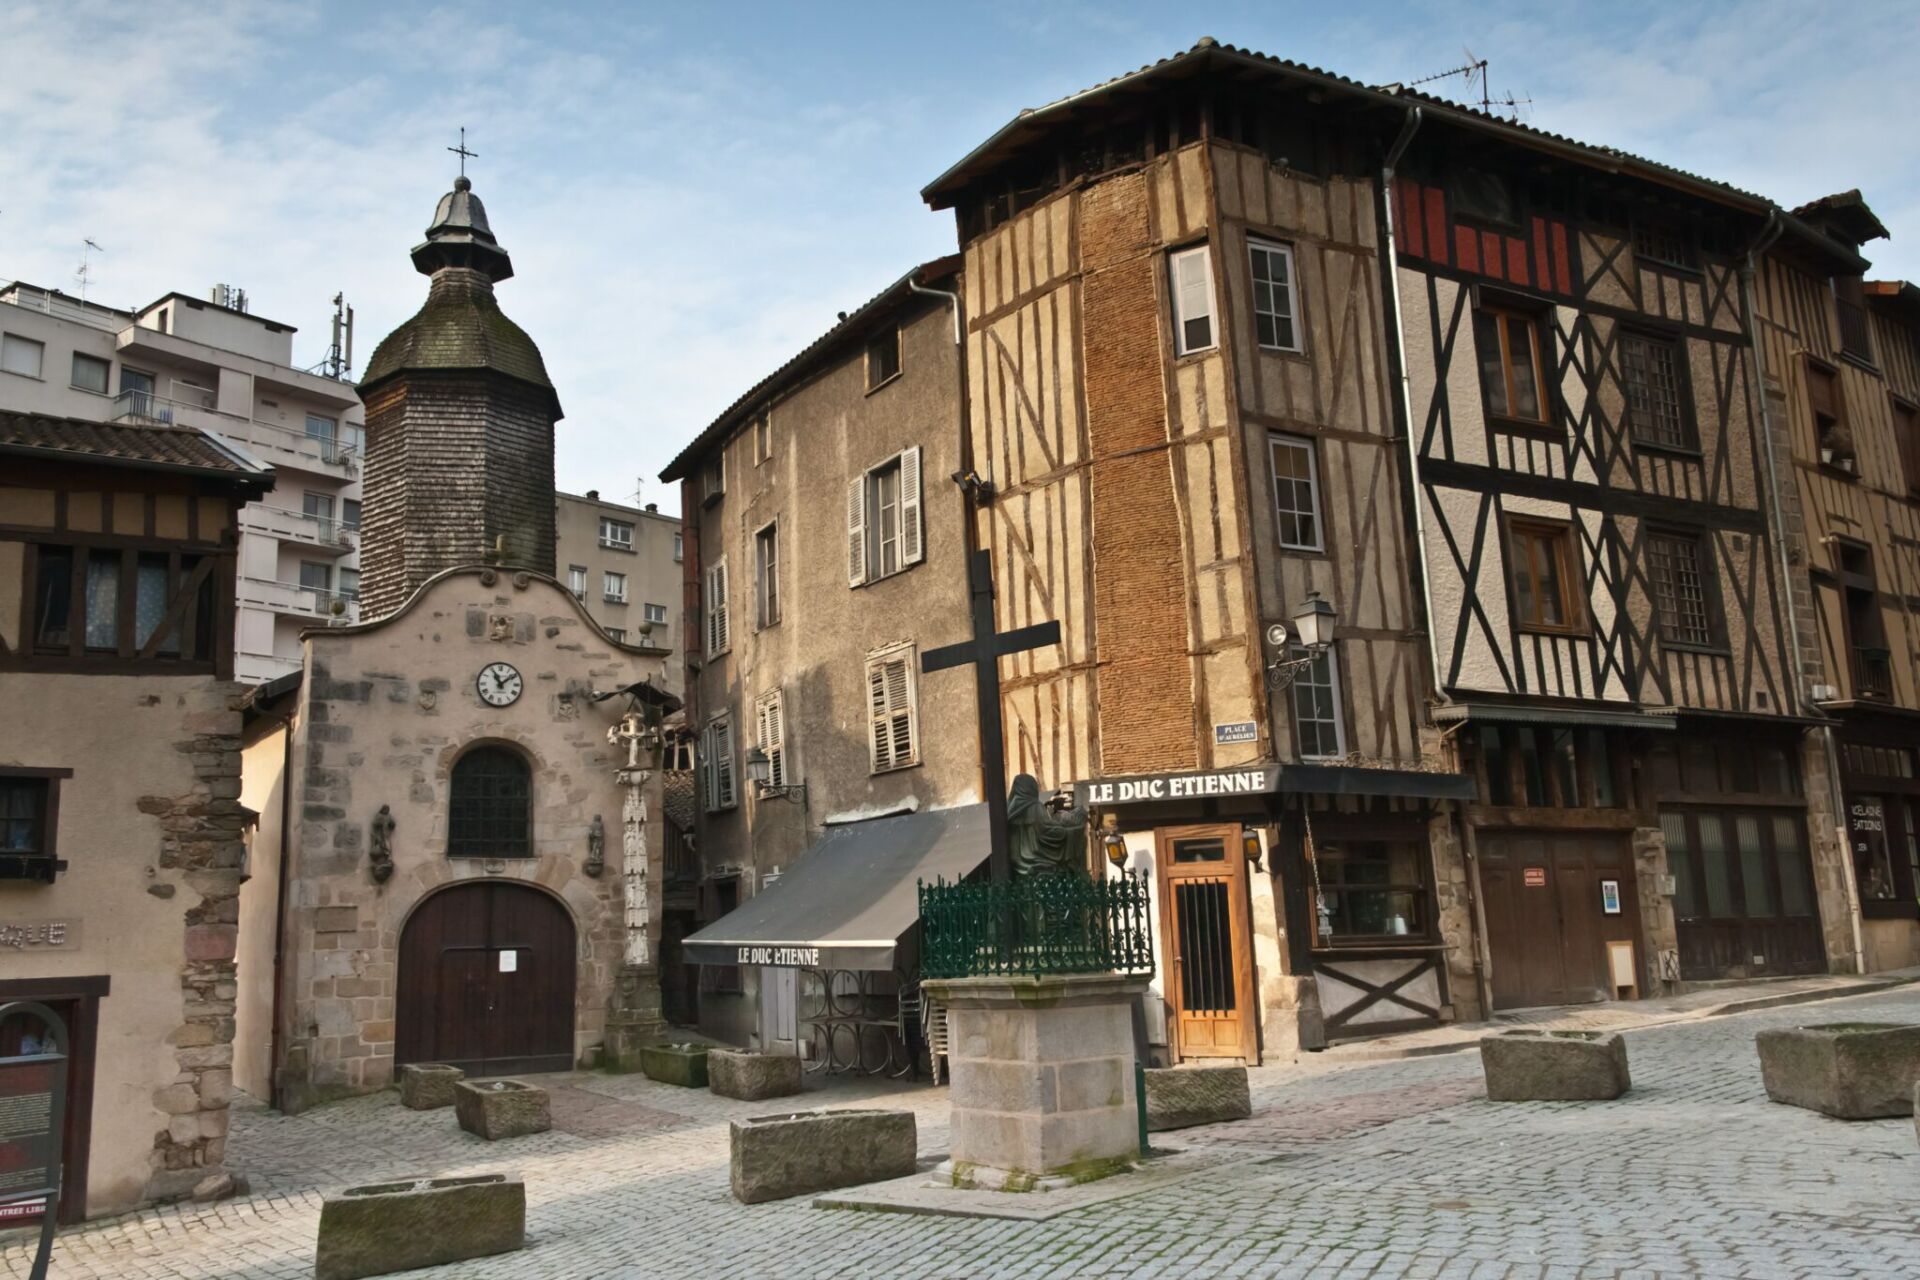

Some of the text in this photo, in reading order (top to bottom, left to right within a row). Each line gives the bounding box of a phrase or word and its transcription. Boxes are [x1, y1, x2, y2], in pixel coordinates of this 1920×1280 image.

[1224, 724, 1248, 735] PLACE
[1088, 771, 1266, 803] LE DUC ETIENNE
[738, 947, 750, 964] LE
[751, 948, 773, 965] DUC
